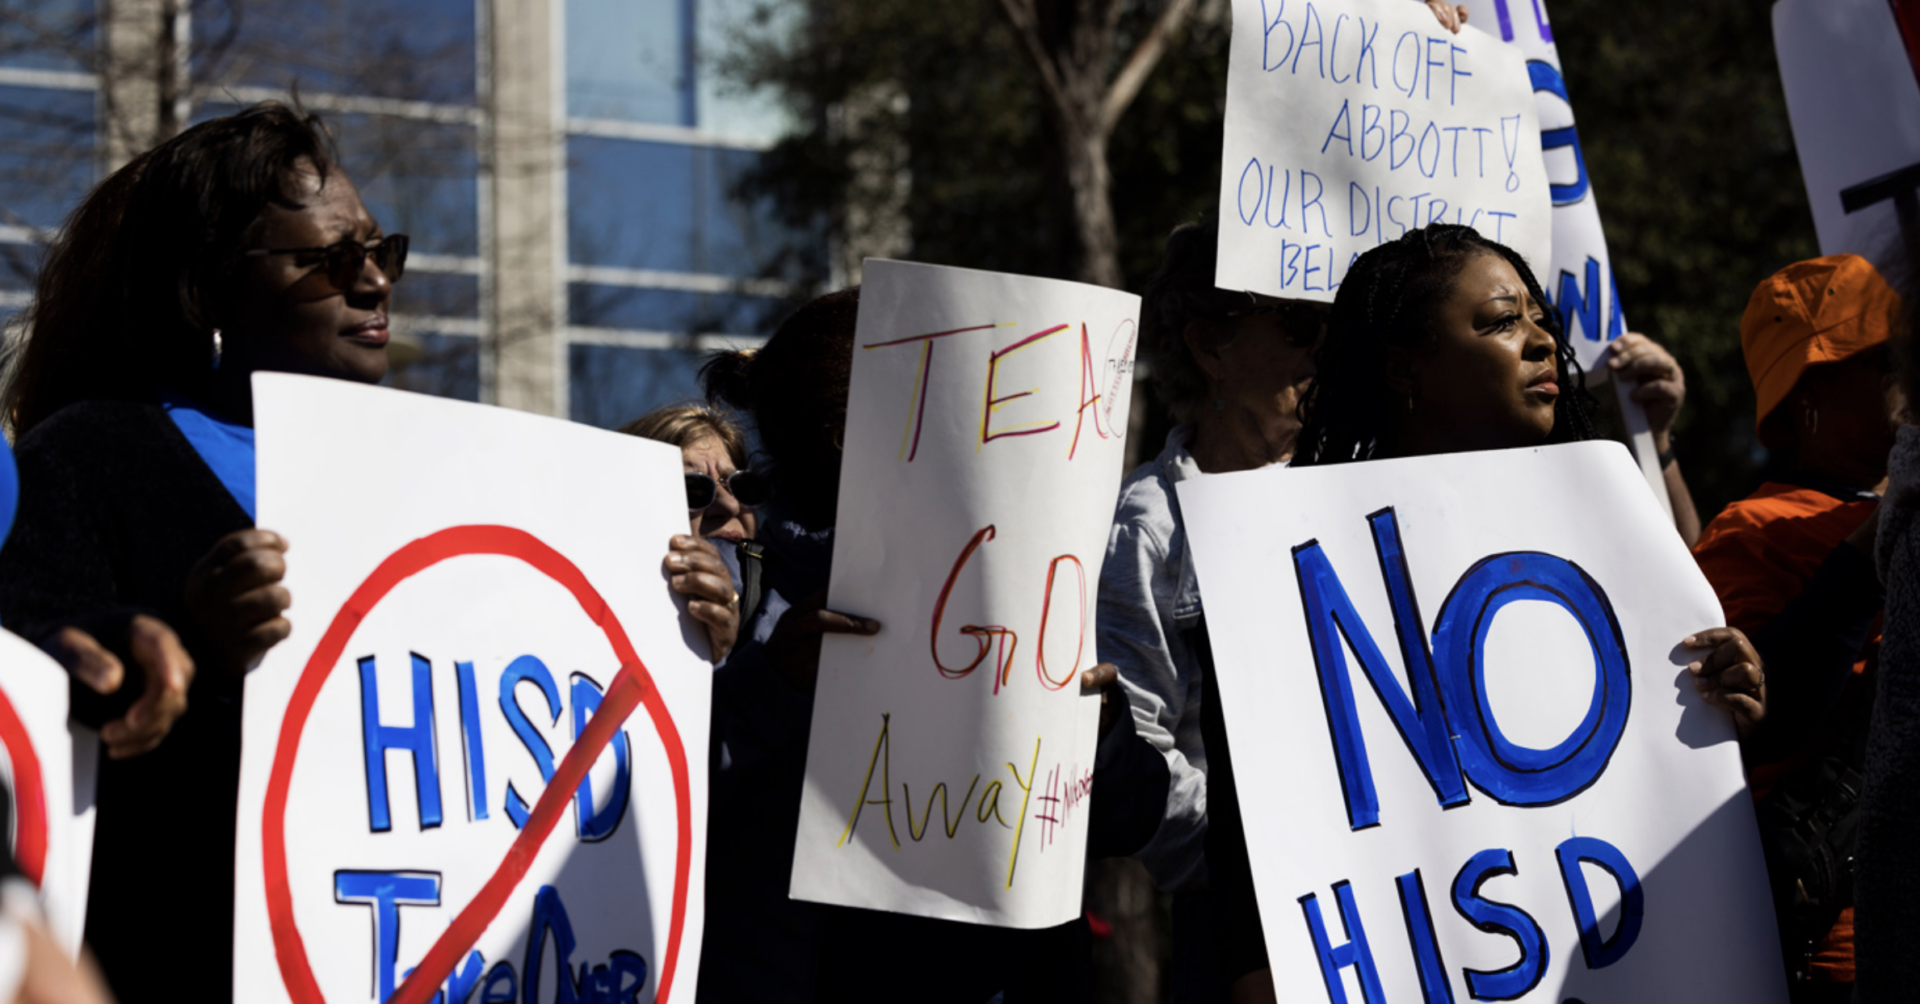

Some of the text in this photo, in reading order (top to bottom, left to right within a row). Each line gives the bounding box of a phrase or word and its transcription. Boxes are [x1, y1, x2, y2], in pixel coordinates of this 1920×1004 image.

[1261, 0, 1473, 106] BACK OFF
[1237, 157, 1333, 238] OUR
[1320, 98, 1521, 193] ABBOTT!
[1280, 238, 1358, 292] BEL
[862, 320, 1110, 463] TEA
[930, 523, 1087, 696] GO
[1290, 505, 1632, 832] NO
[356, 650, 632, 843] HISD
[1296, 836, 1645, 1004] HISD
